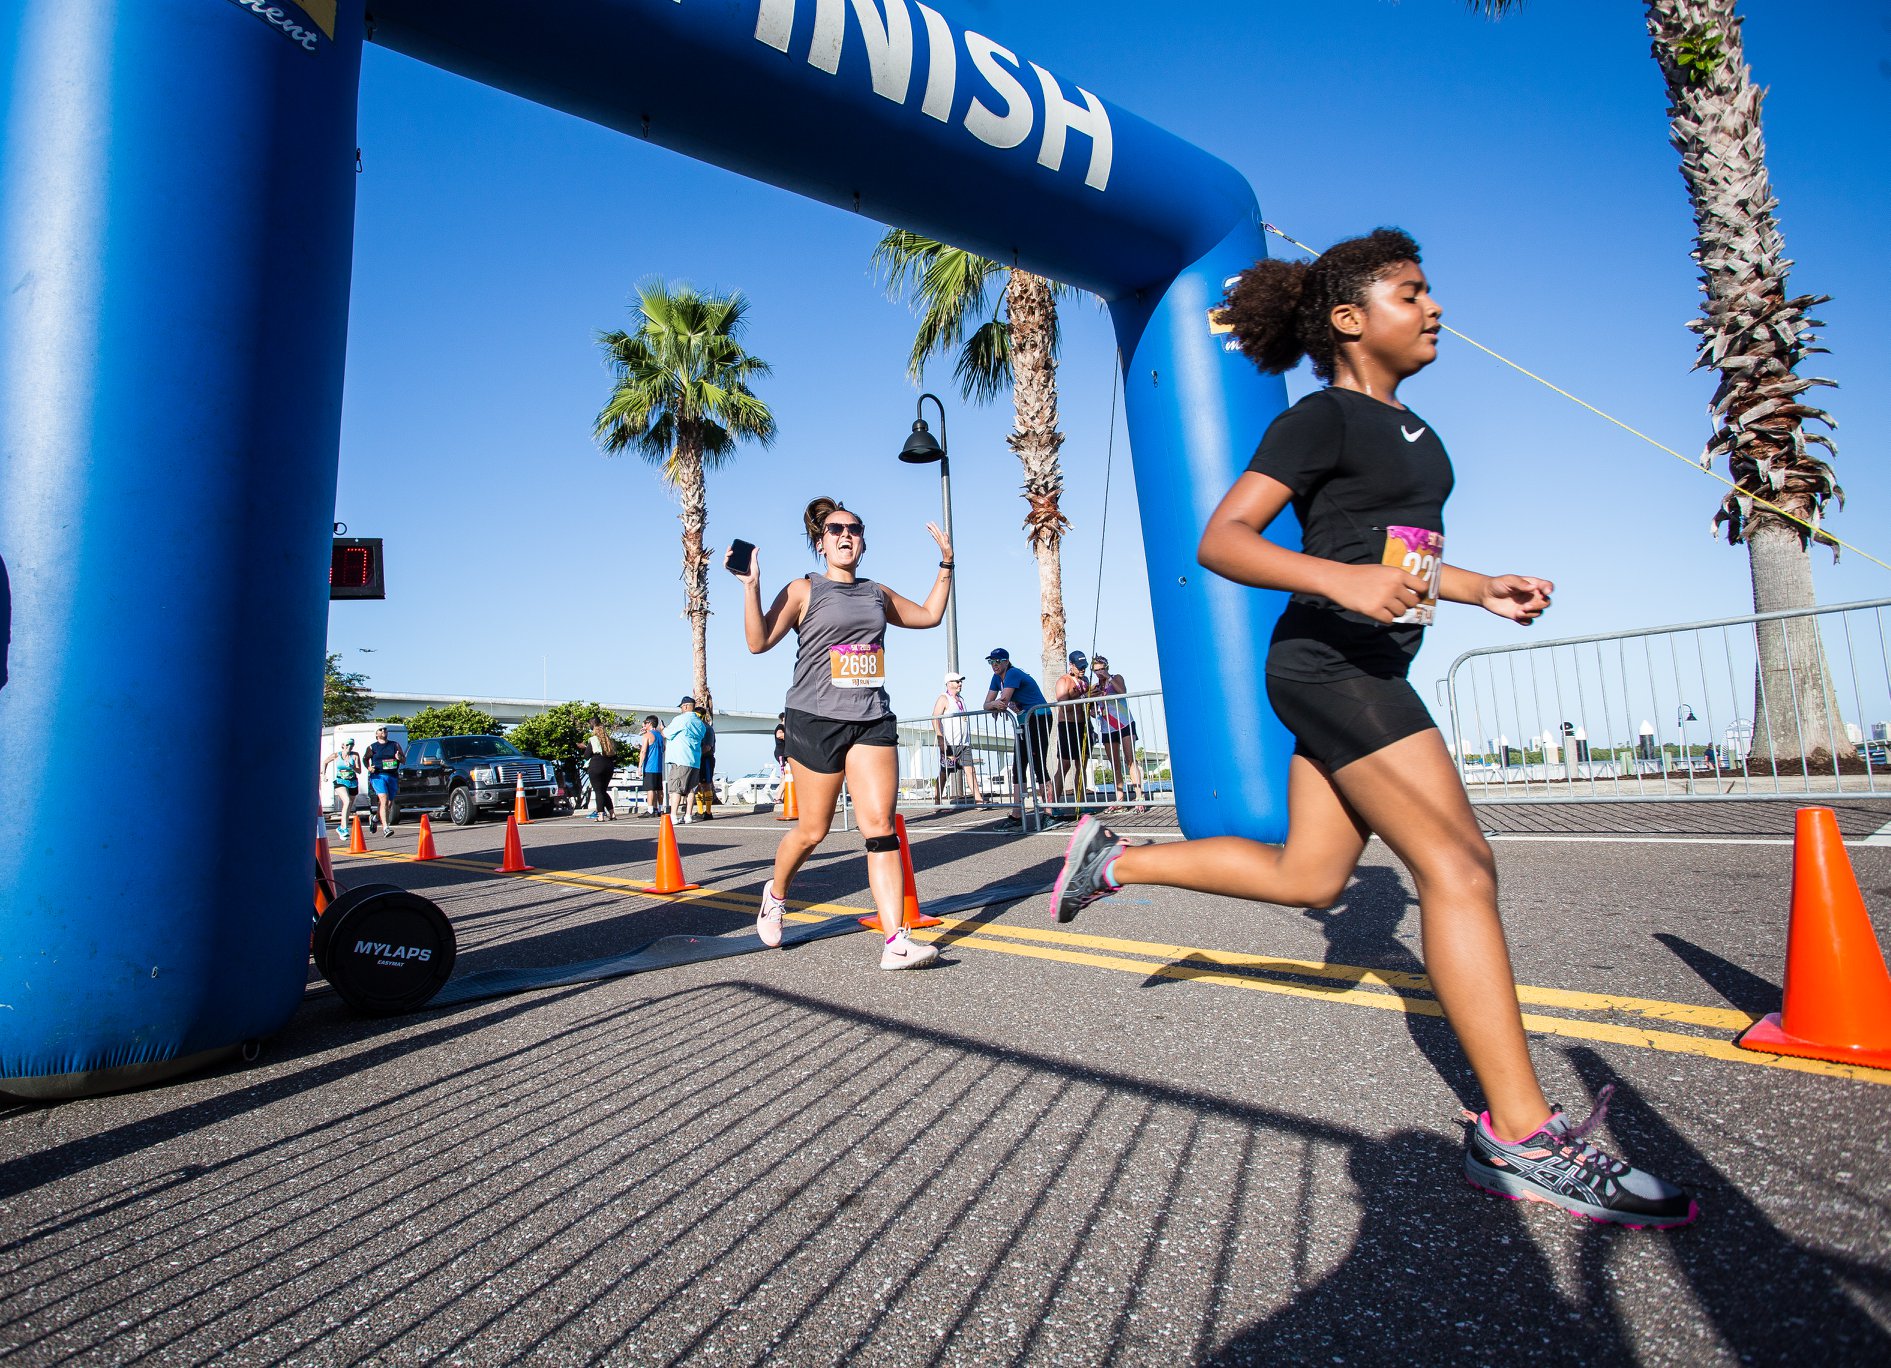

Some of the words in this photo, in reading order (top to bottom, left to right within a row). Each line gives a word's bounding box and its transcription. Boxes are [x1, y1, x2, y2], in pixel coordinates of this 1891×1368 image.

[754, 0, 1113, 192] NISH
[840, 655, 876, 675] 2698
[354, 940, 432, 961] MYLAPS
